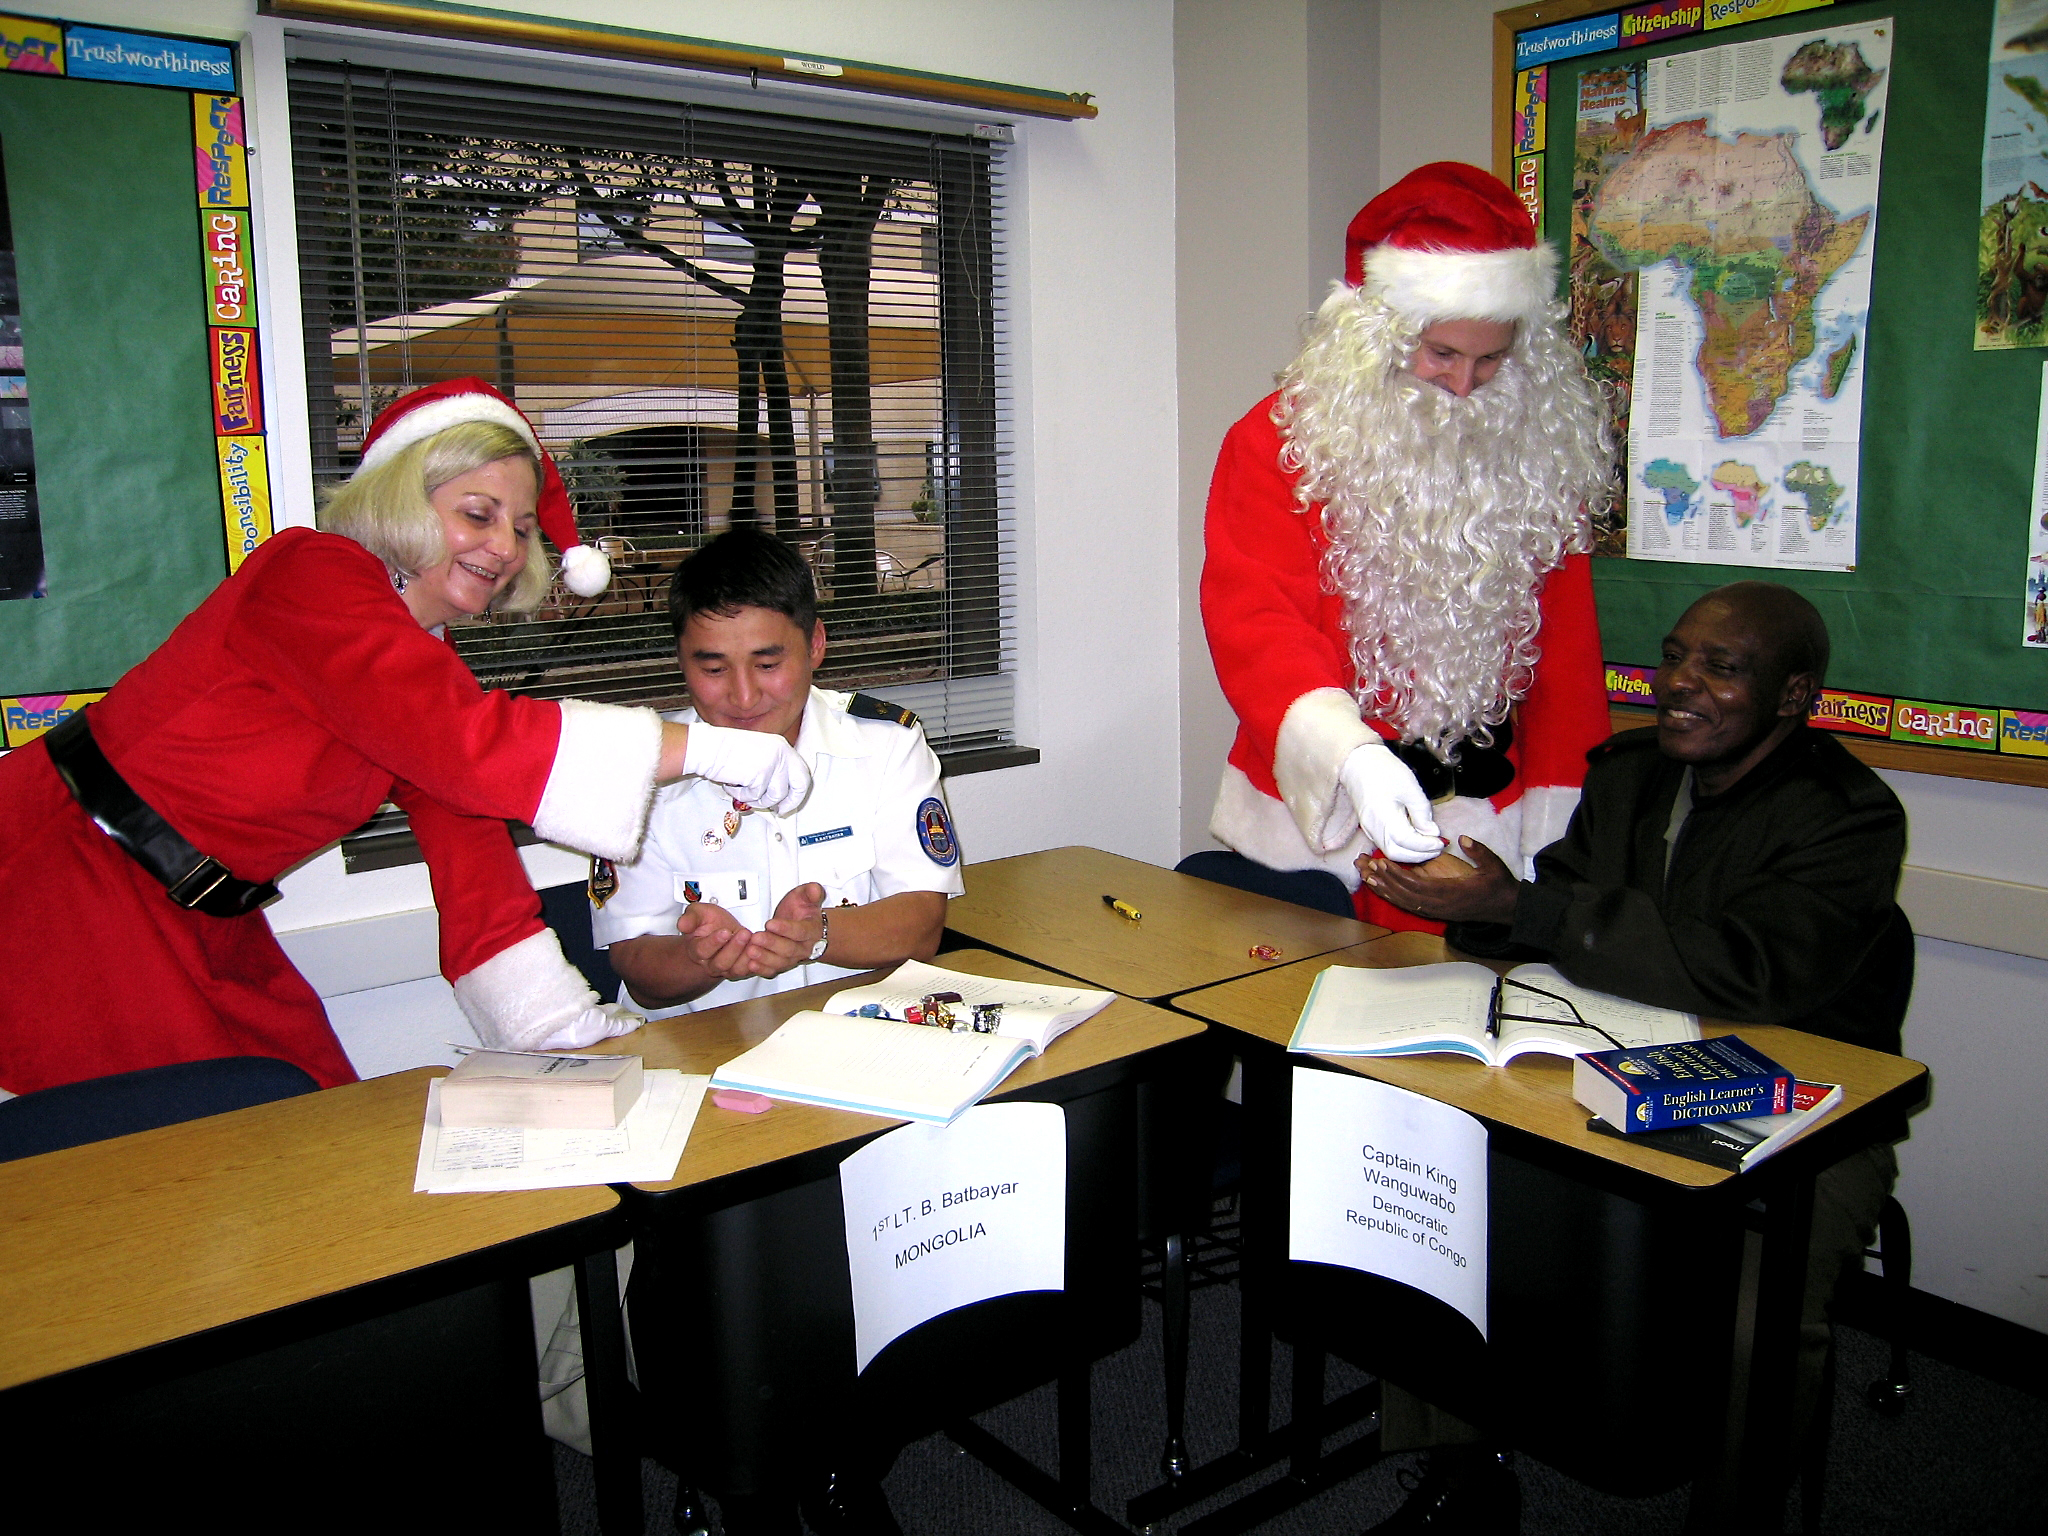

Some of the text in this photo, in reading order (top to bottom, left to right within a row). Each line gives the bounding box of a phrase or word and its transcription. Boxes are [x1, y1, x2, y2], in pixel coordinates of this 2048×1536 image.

[1621, 7, 1701, 37] Citizenship
[1710, 0, 1773, 20] Respo
[66, 37, 230, 77] Trustworthiness
[1517, 24, 1617, 57] Trustworthiness
[801, 61, 825, 70] WORLD
[1579, 96, 1626, 111] Realms
[1580, 83, 1628, 99] Natural
[219, 331, 250, 432] Fairness
[229, 443, 258, 554] ponsibility
[1605, 669, 1653, 696] Citizen
[1810, 693, 1889, 727] Fairness
[2002, 717, 2048, 746] Res
[1647, 1051, 1694, 1079] English
[1663, 1089, 1706, 1108] English
[1710, 1083, 1764, 1101] Learner's
[1672, 1100, 1754, 1121] DICTIONARY
[1362, 1144, 1457, 1195] Captain King
[894, 1206, 916, 1229] LT.
[921, 1199, 936, 1216] B.
[942, 1182, 1019, 1209] Batbayar
[1363, 1166, 1456, 1214] Wanguwabo
[1373, 1195, 1448, 1236] Democratic
[895, 1222, 986, 1269] MONGOLIA
[1346, 1209, 1467, 1268] Republic of Congo
